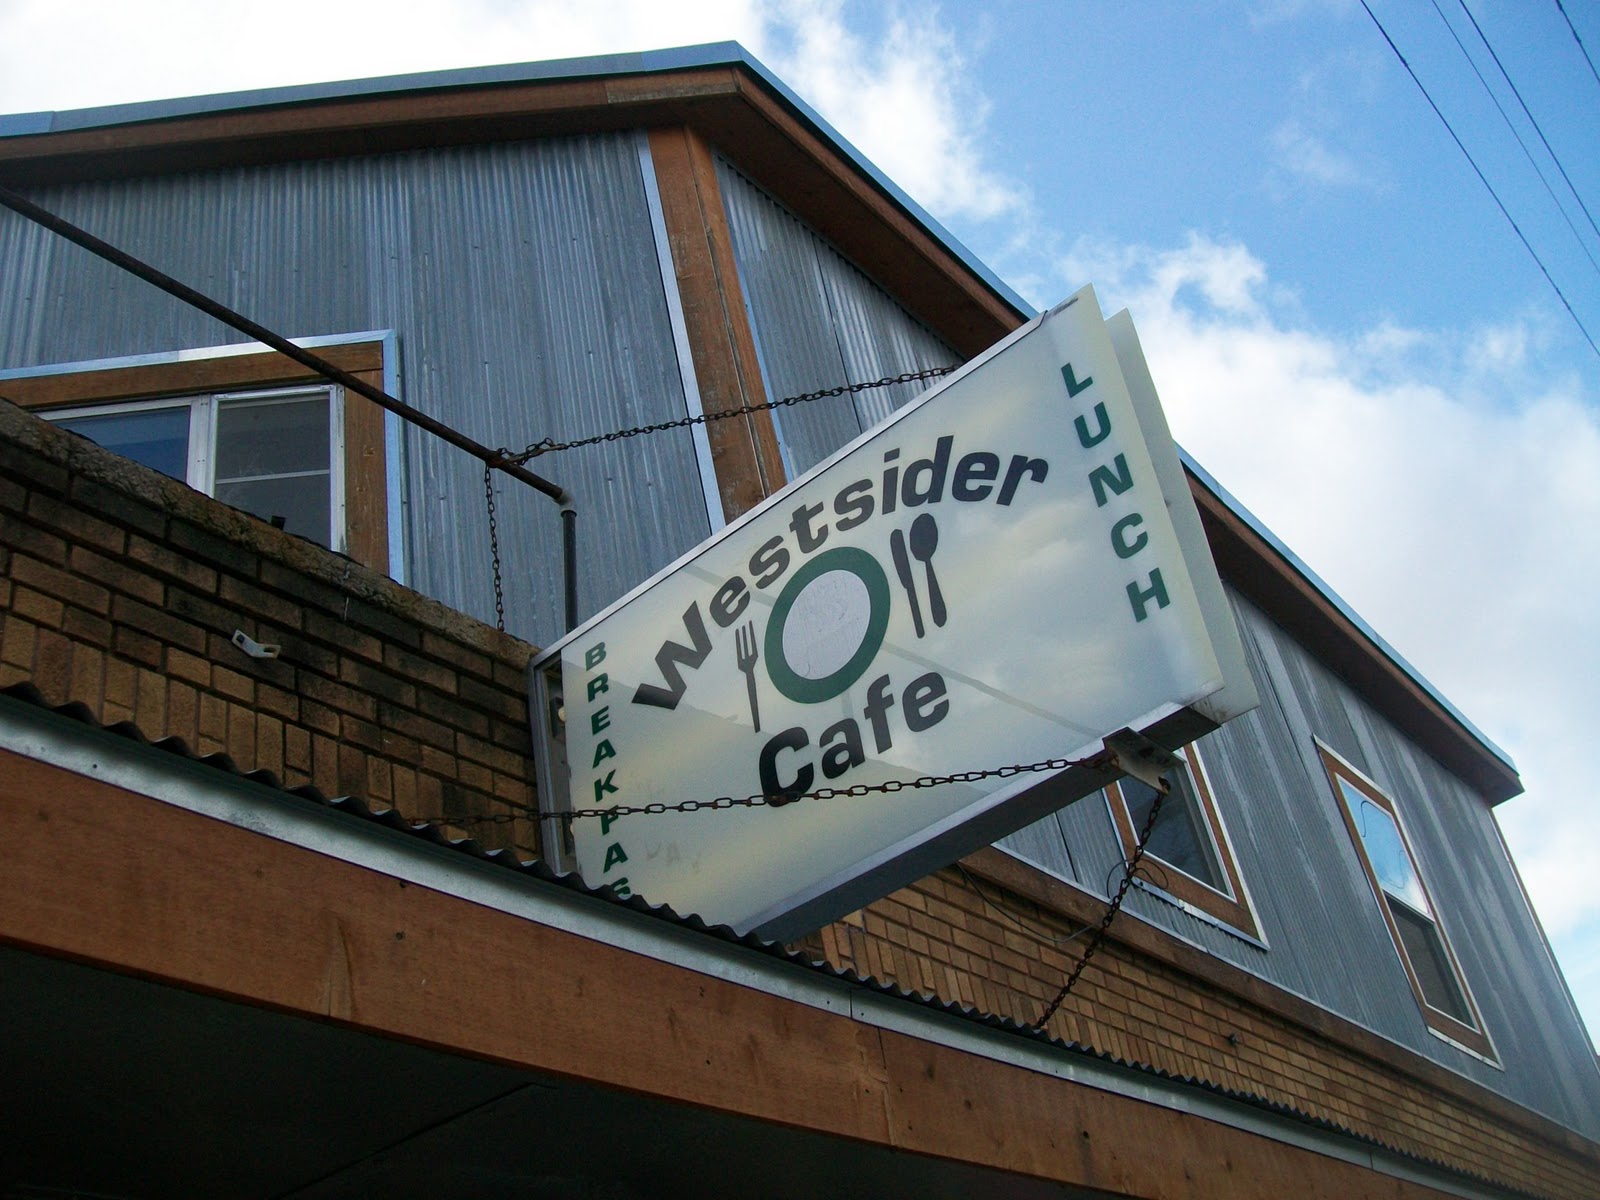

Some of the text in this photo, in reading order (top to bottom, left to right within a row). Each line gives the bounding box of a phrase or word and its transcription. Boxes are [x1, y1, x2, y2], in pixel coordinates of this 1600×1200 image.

[631, 435, 1050, 710] Westsider
[1061, 362, 1170, 623] LUNCH
[759, 672, 950, 807] Cafe
